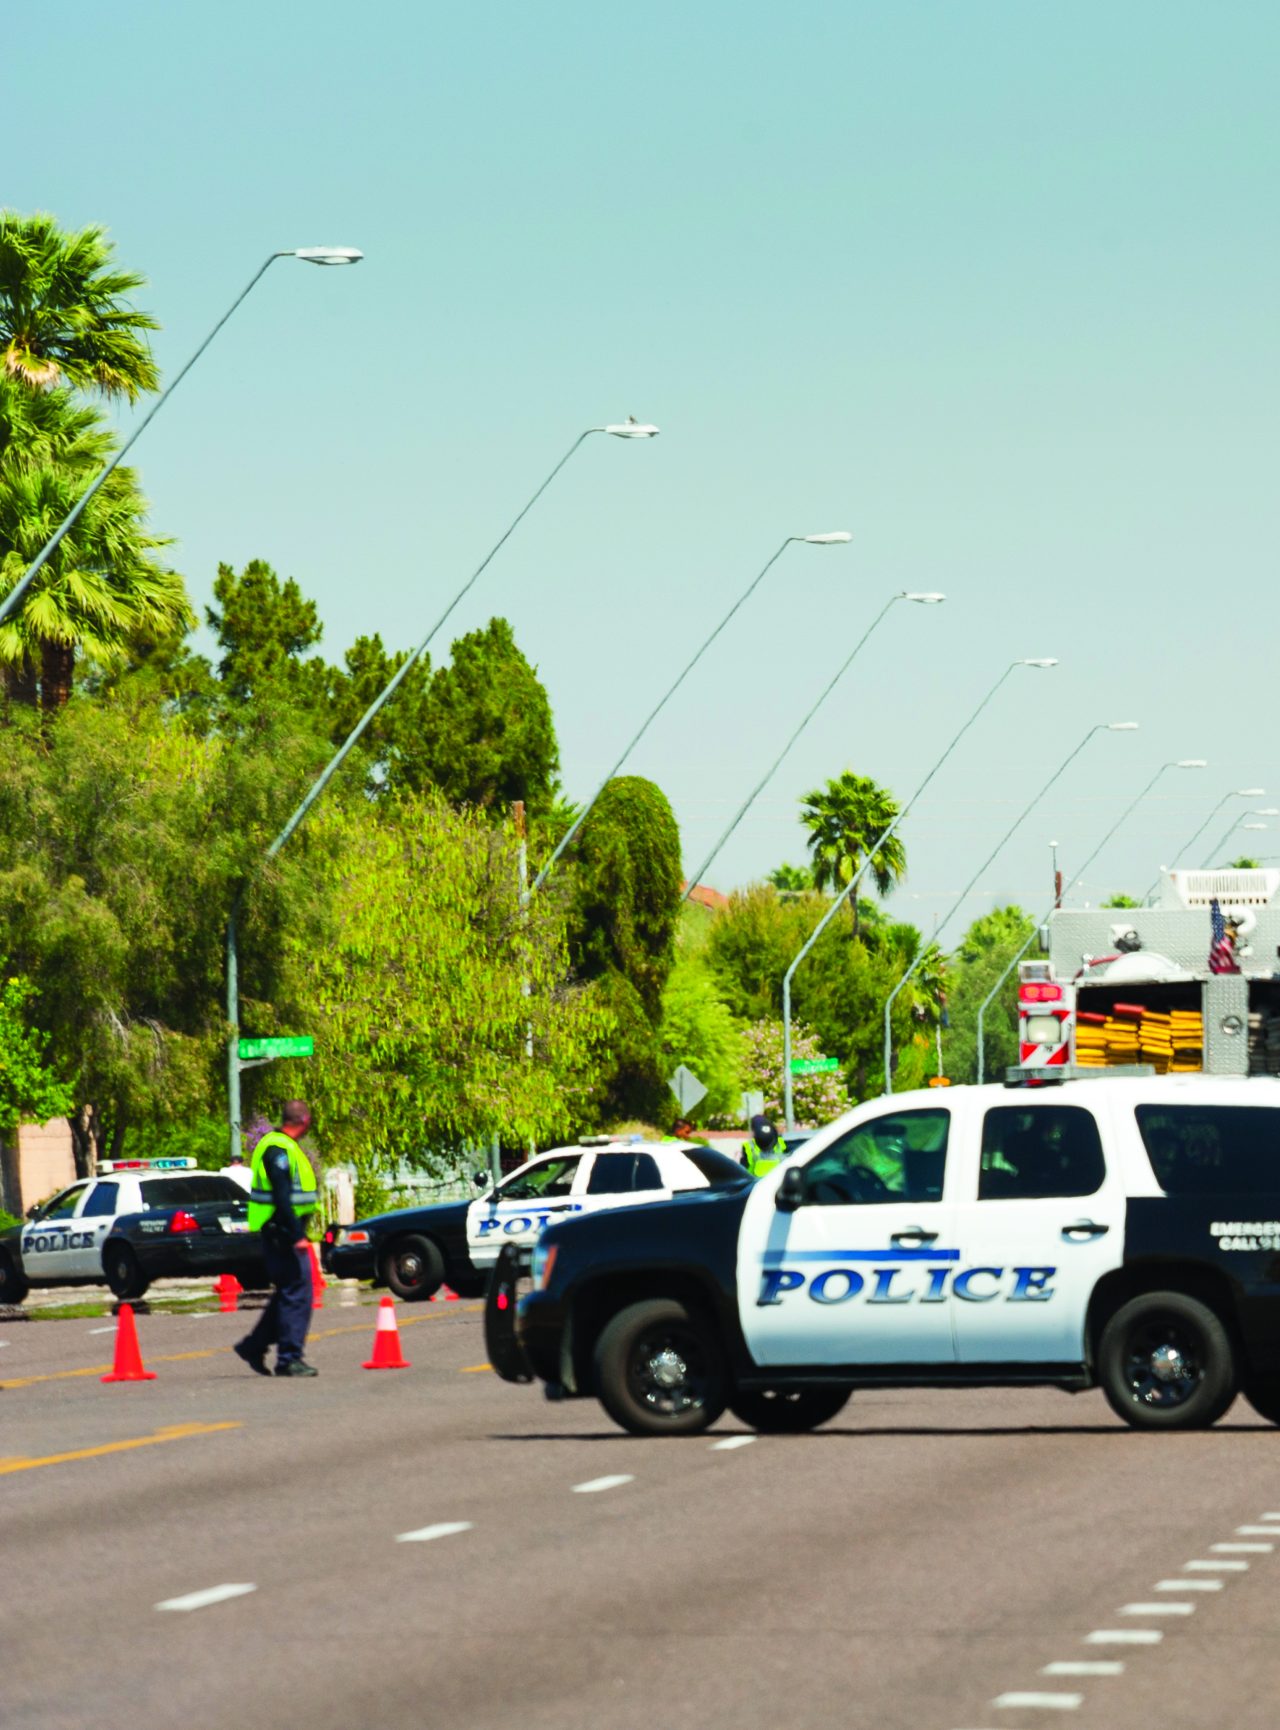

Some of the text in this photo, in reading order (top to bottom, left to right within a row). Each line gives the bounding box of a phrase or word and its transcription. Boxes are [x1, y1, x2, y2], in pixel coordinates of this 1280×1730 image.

[22, 1231, 95, 1254] POLICE
[1219, 1236, 1260, 1251] CALL
[756, 1266, 1056, 1307] POLICE
